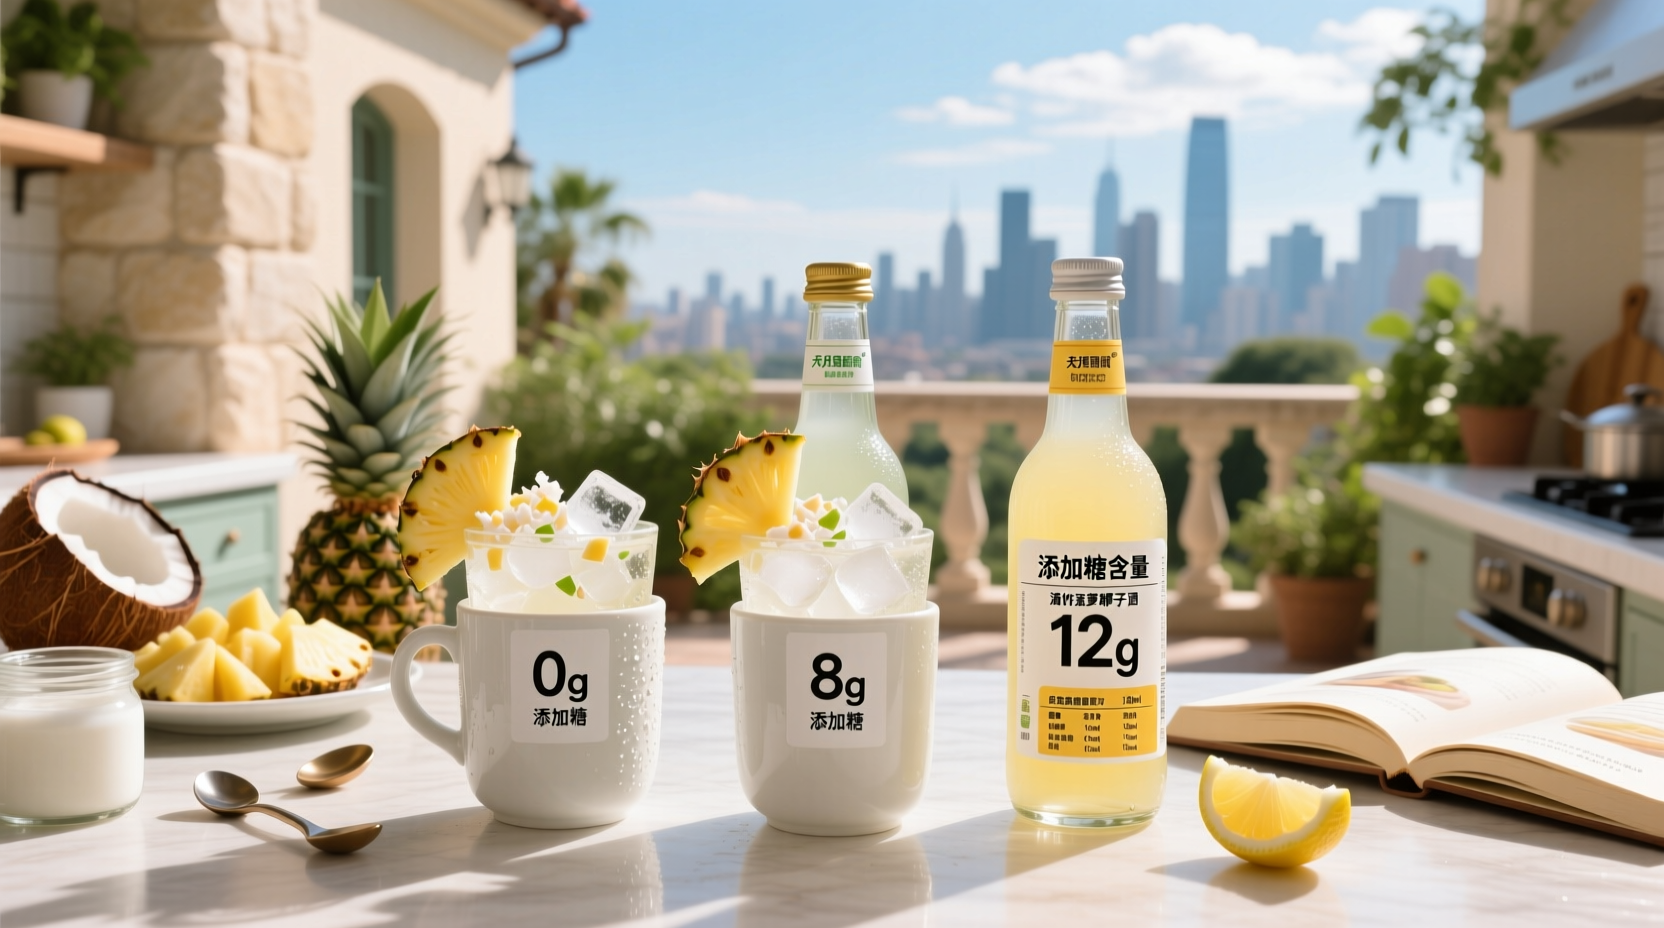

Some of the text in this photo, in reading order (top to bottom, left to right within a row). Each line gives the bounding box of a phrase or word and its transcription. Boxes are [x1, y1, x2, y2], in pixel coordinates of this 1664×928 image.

[1037, 553, 1150, 581] 添加糖含量
[1050, 613, 1139, 678] 12g
[532, 649, 589, 703] 0g
[810, 652, 866, 707] 8g
[532, 706, 588, 728] 添加糖
[809, 710, 865, 732] 添加糖
